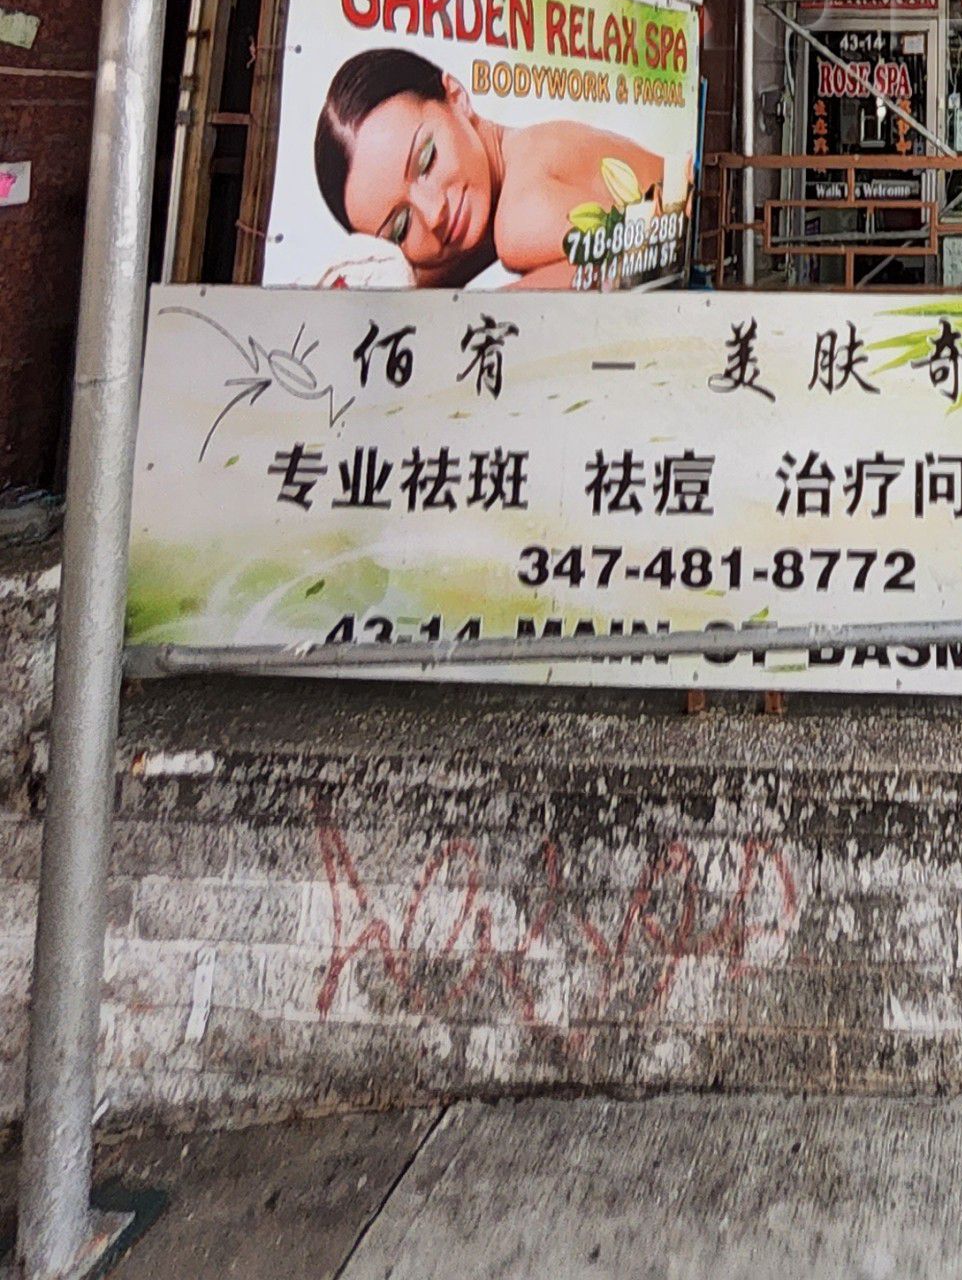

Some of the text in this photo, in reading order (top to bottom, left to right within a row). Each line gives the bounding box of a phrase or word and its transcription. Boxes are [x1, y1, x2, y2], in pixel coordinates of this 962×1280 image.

[545, 0, 640, 67] RELAX
[644, 22, 688, 73] SPA
[840, 33, 885, 52] 43-14
[472, 60, 686, 109] BODYWORK & FACIAL
[818, 61, 912, 97] ROSE SPA
[571, 255, 618, 291] 43-14
[622, 246, 658, 277] MAIN
[267, 441, 530, 514] 专业祛斑
[585, 447, 716, 517] 祛痘
[518, 544, 917, 593] 347-481-8772
